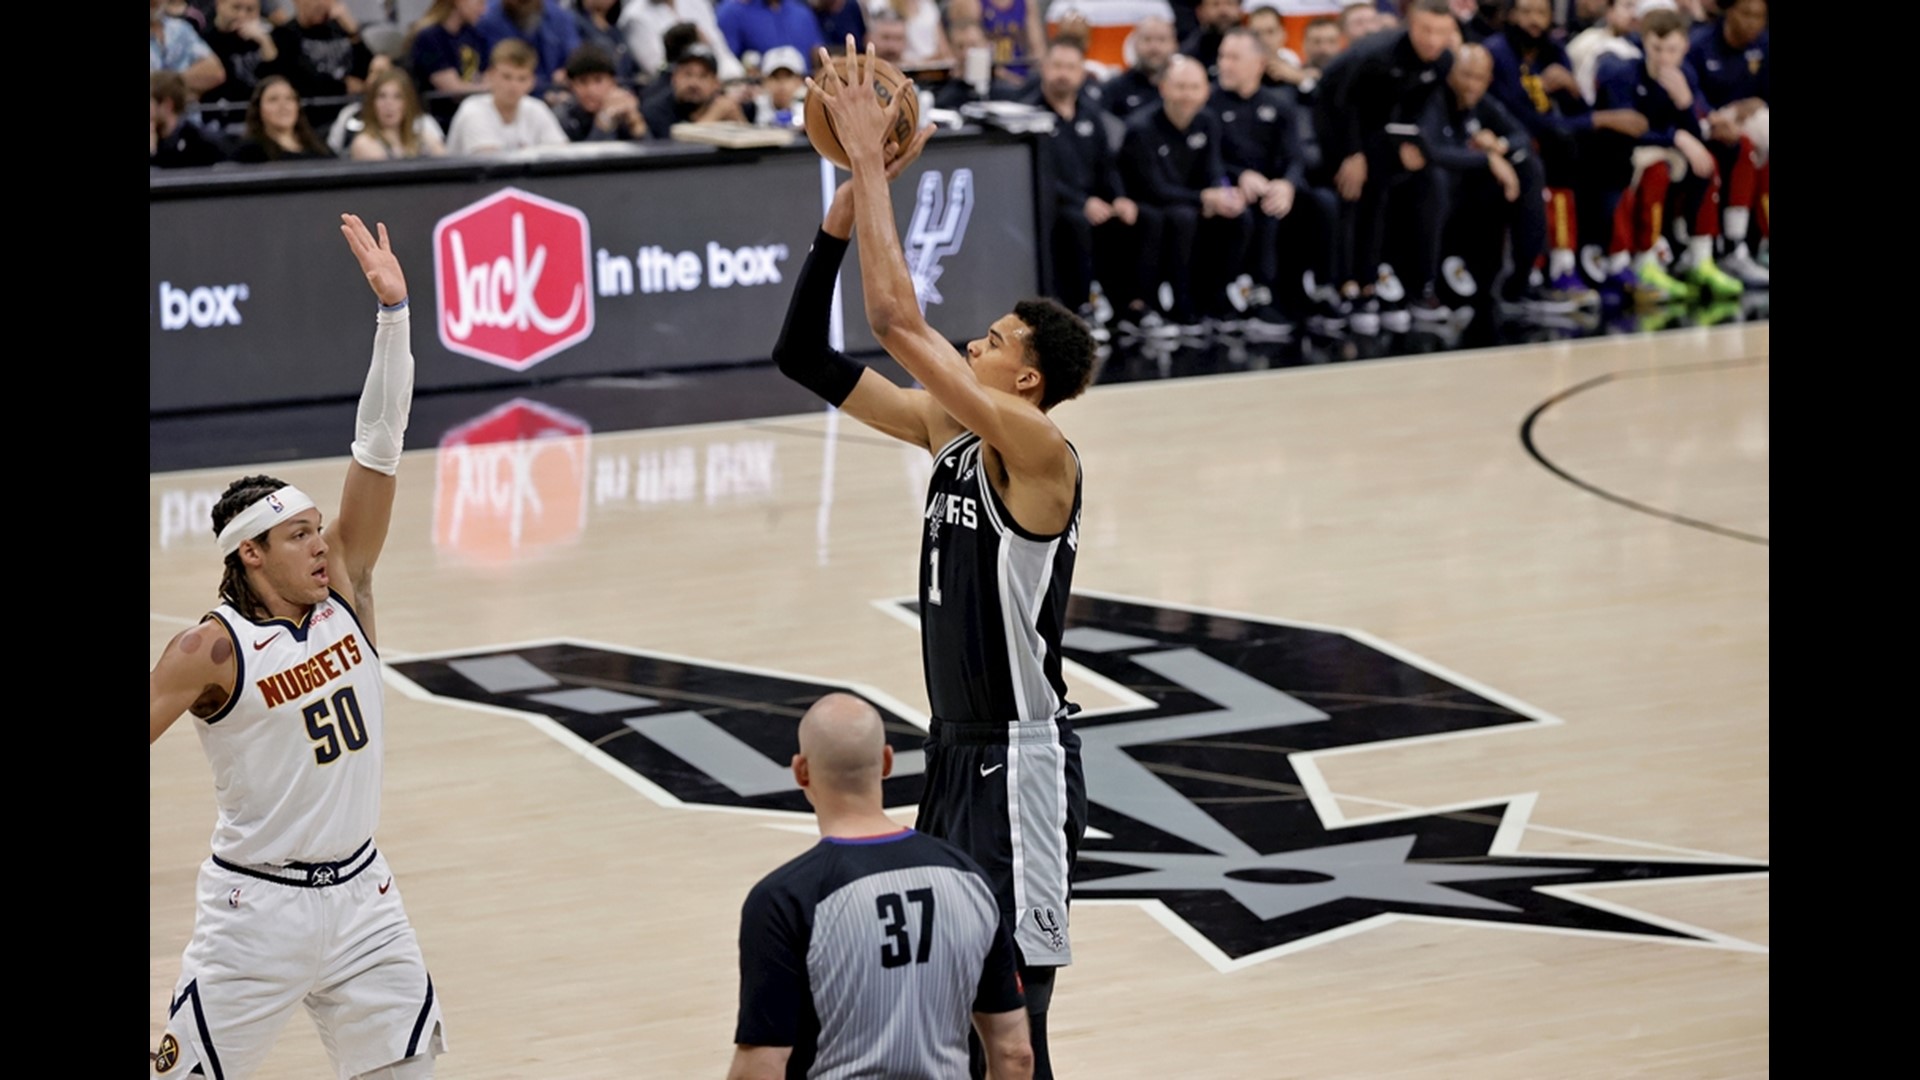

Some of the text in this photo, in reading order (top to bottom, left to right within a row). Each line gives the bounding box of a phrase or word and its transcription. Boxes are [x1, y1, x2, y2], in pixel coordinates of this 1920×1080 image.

[447, 212, 584, 340] Jack
[597, 248, 634, 297] in
[637, 245, 702, 294] the
[928, 547, 942, 606] 1
[256, 633, 363, 710] NUGGETS
[302, 685, 369, 766] 50
[876, 885, 936, 970] 37
